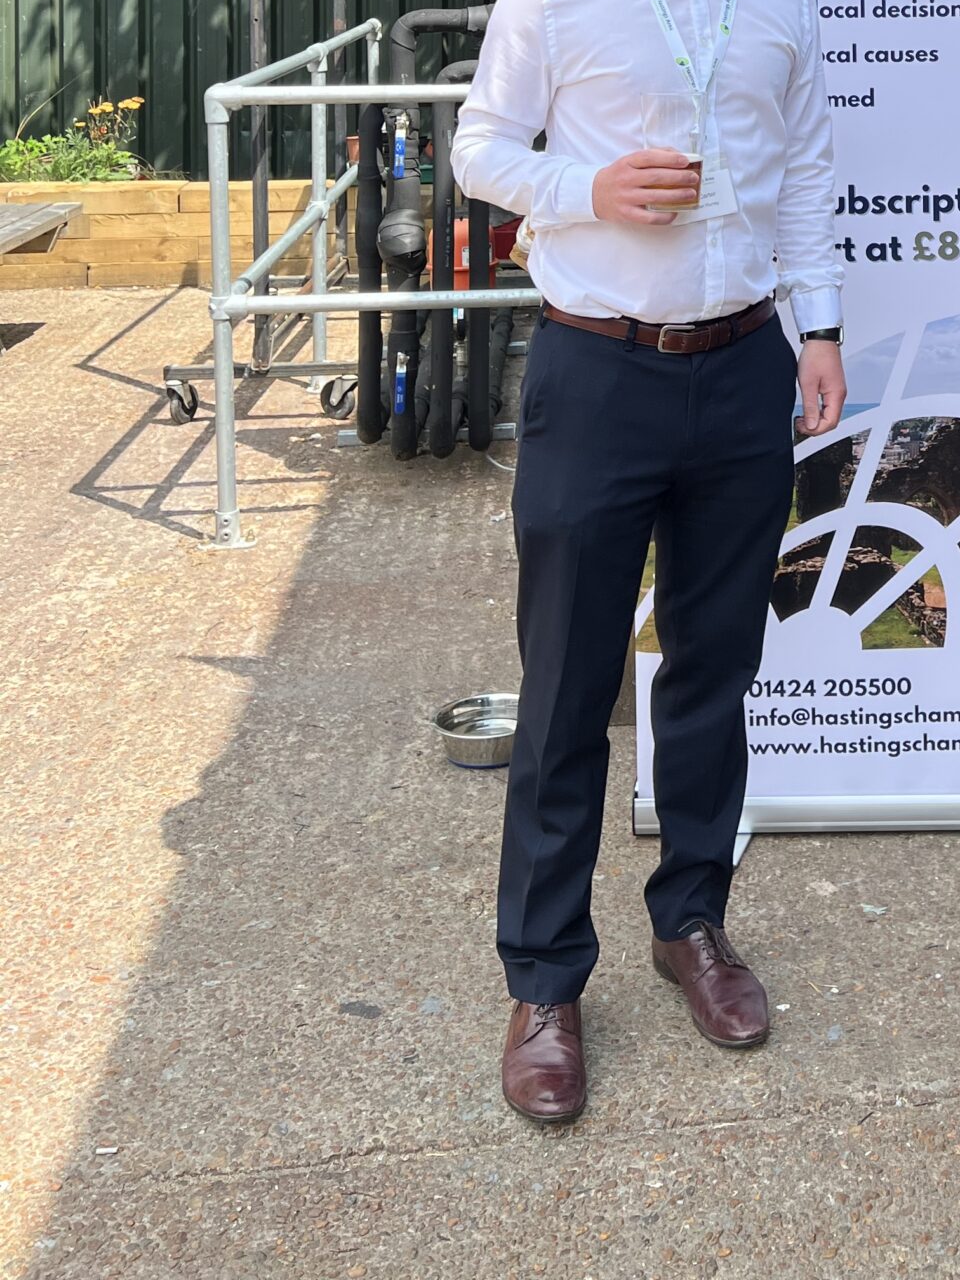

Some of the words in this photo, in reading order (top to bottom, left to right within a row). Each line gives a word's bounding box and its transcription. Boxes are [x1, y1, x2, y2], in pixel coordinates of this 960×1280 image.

[864, 48, 939, 63] causes
[865, 236, 903, 262] at
[748, 679, 817, 698] 01424
[823, 677, 912, 697] 205500
